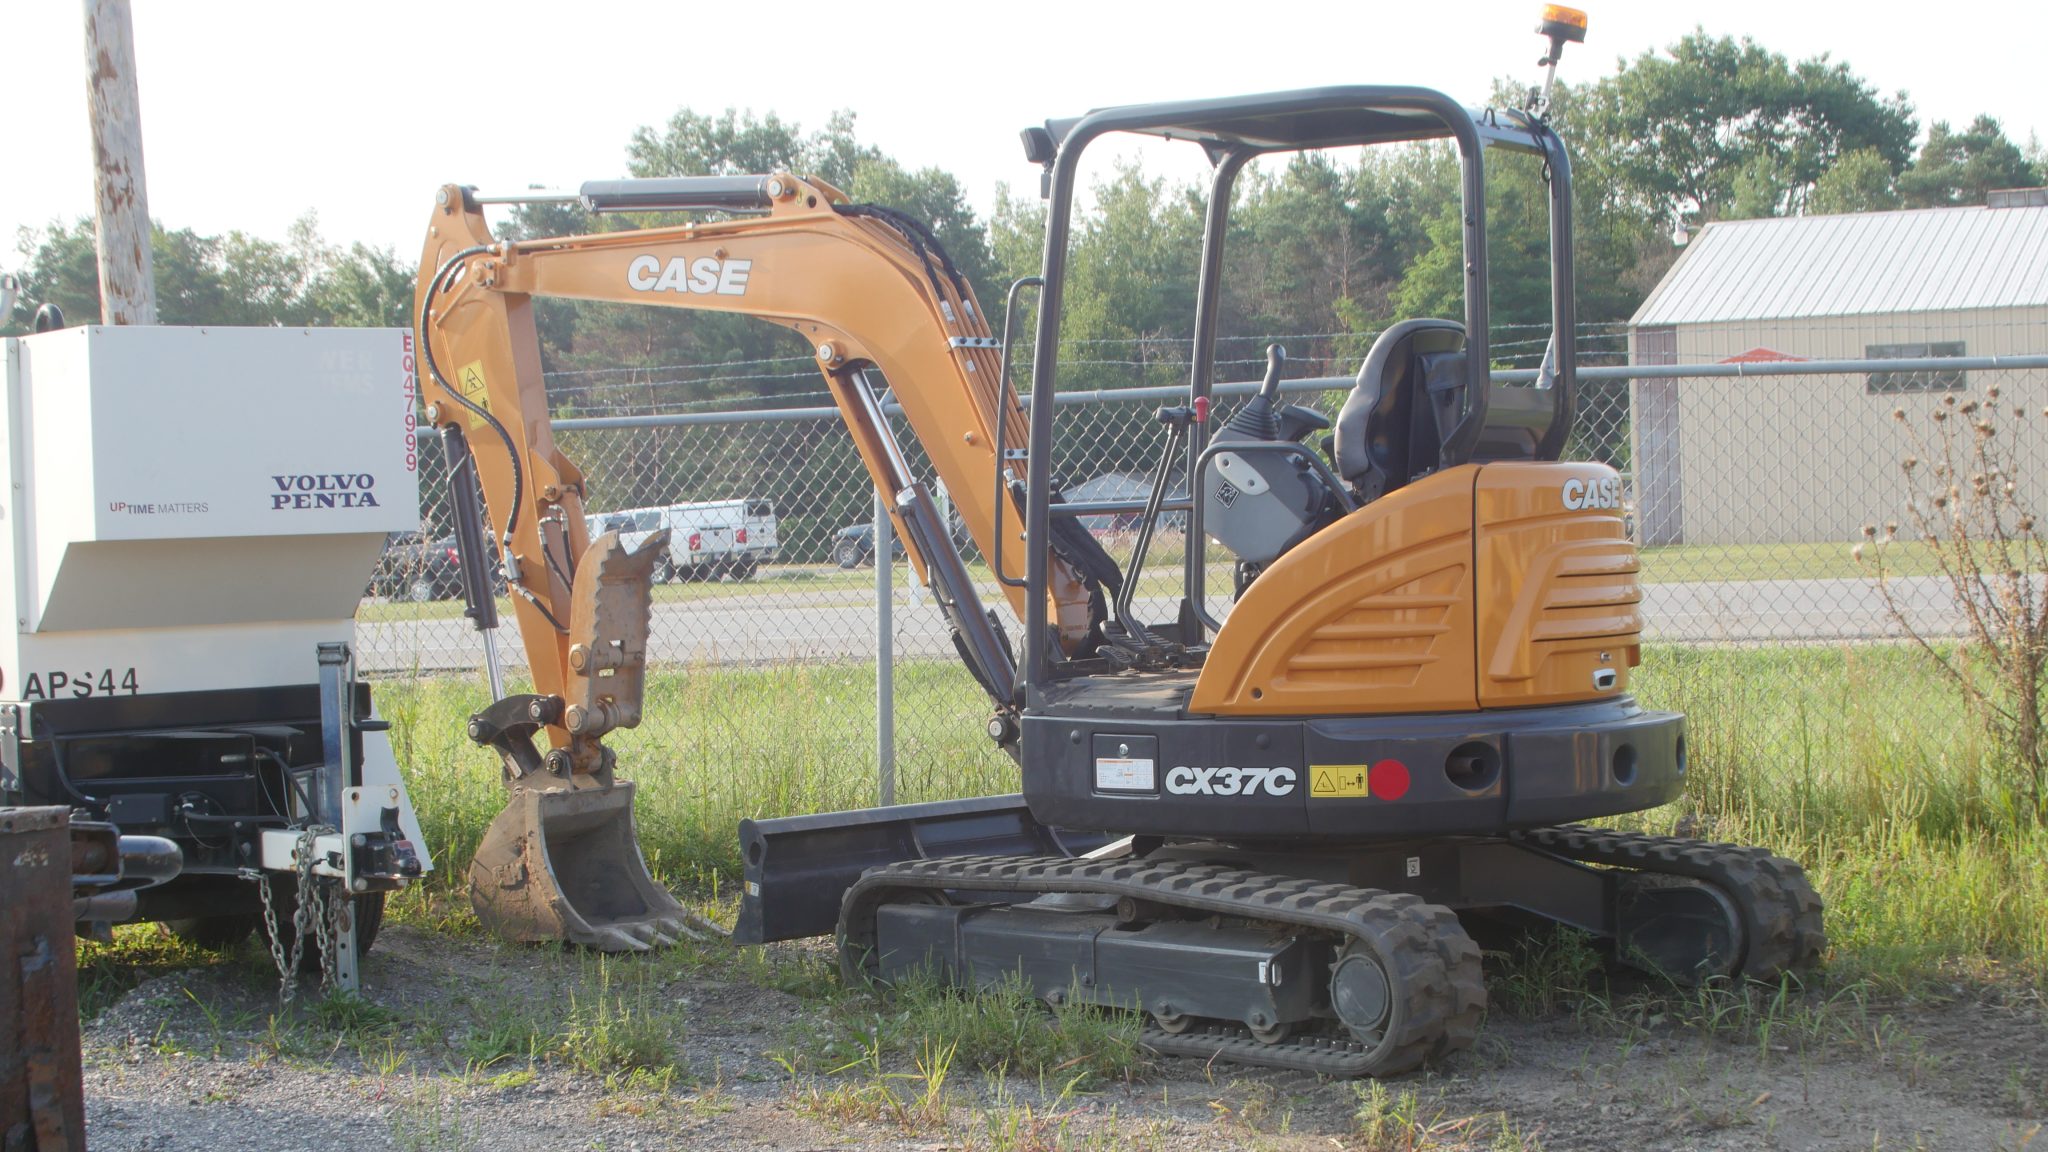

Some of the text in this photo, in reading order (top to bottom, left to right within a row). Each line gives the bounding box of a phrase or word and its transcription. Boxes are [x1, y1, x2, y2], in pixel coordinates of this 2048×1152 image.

[627, 254, 752, 296] CASE
[402, 335, 417, 472] EQ47999
[271, 473, 375, 491] VOLVO
[1562, 477, 1621, 511] CASE
[157, 502, 209, 513] MATTERS
[271, 492, 381, 510] PENTA
[22, 667, 139, 700] APS44
[1165, 766, 1297, 796] CX37C
